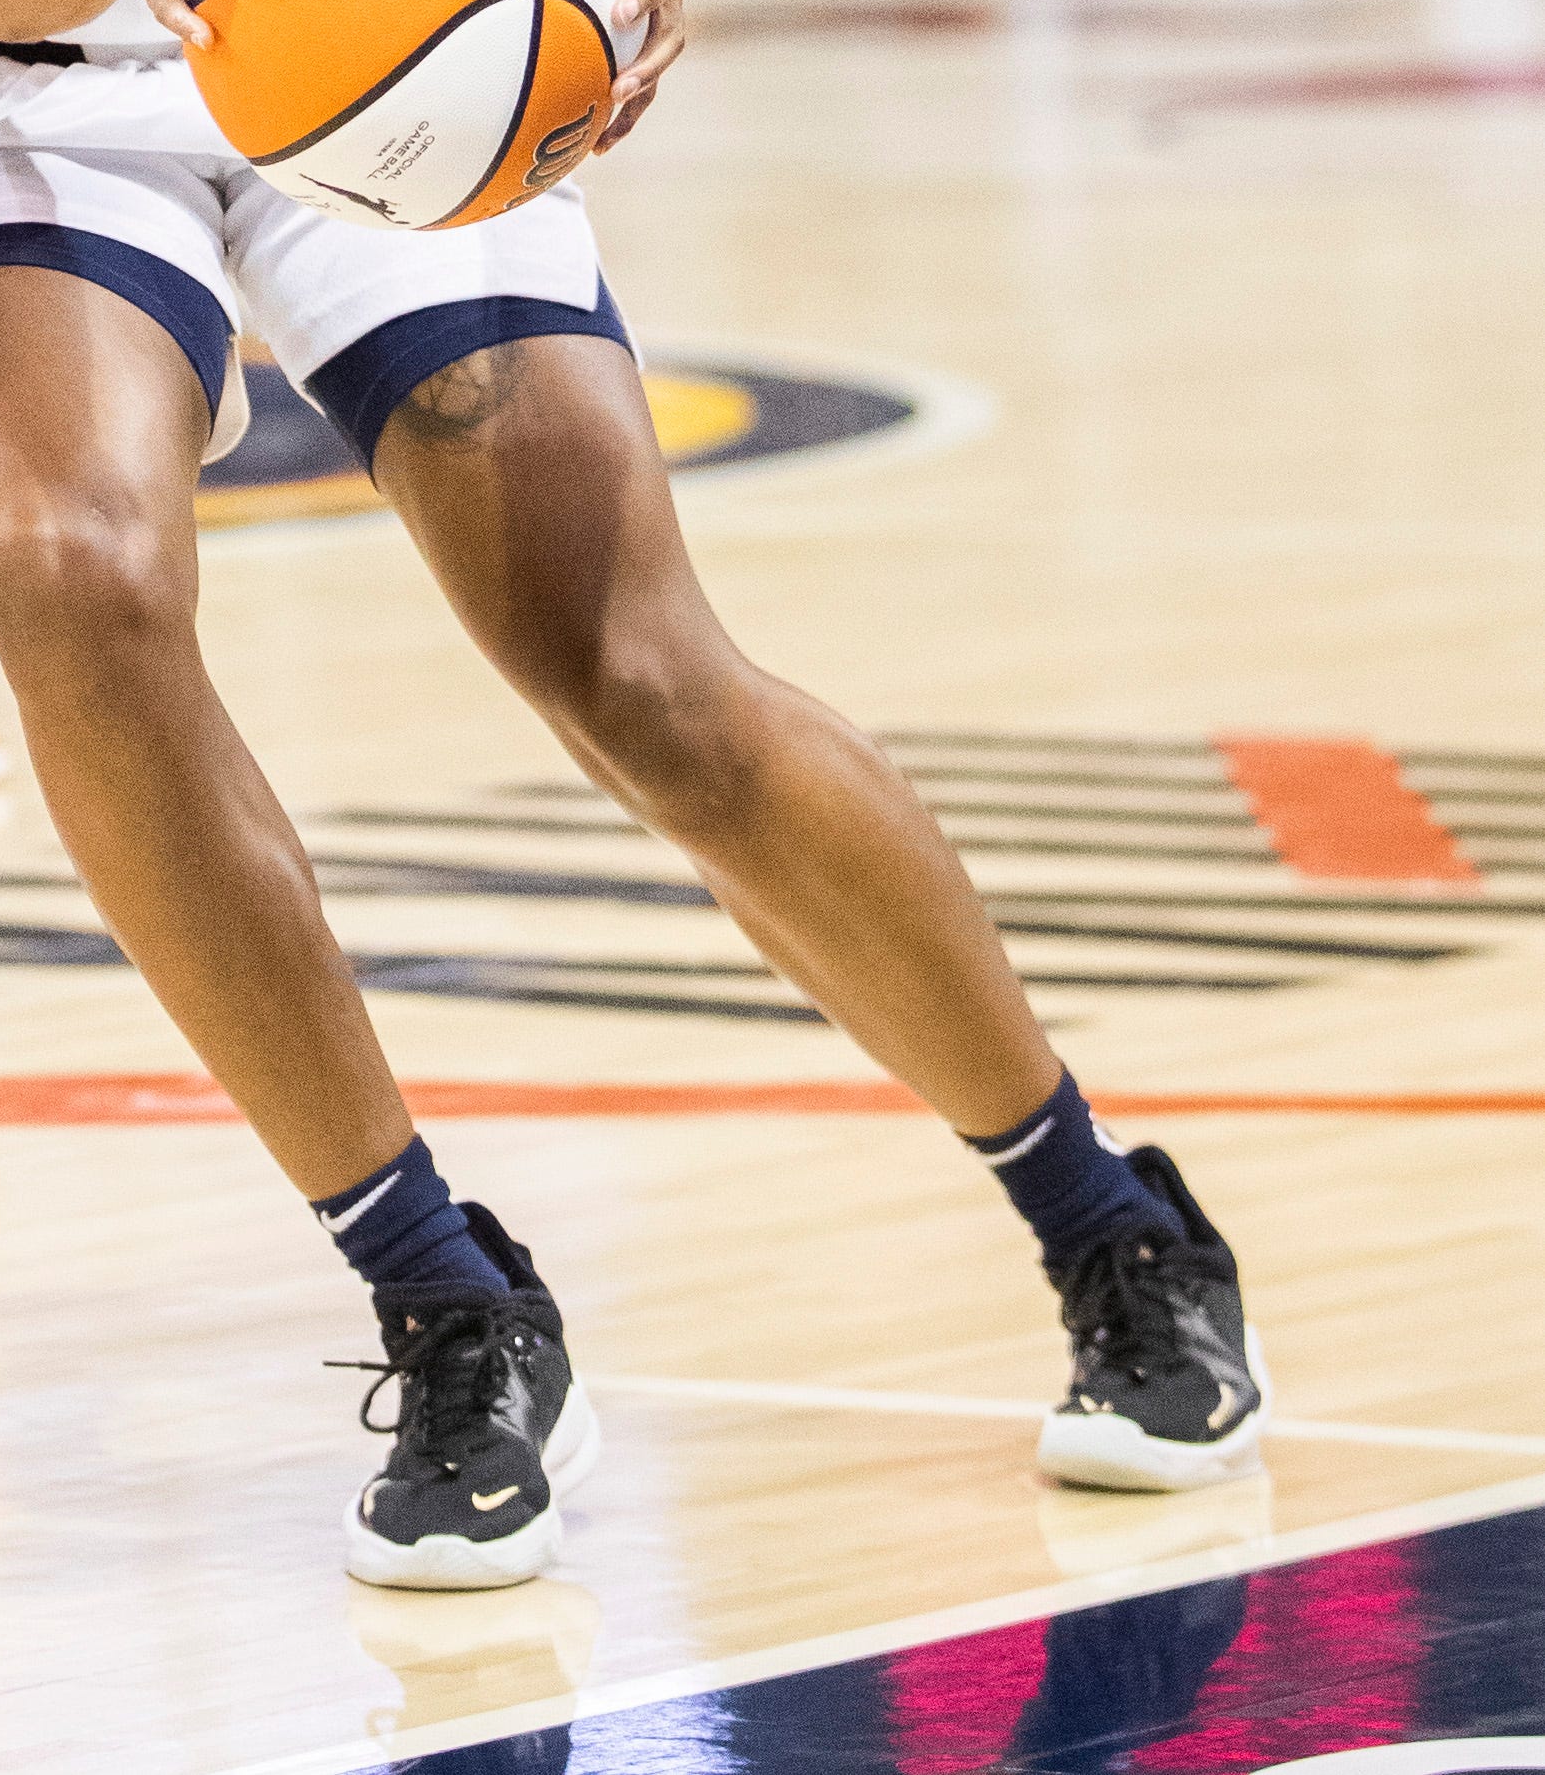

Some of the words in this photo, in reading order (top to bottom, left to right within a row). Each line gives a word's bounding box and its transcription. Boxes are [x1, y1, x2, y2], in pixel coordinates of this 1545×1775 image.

[395, 121, 429, 157] GAME
[366, 156, 398, 179] BALL
[385, 135, 435, 180] OFFICIAL
